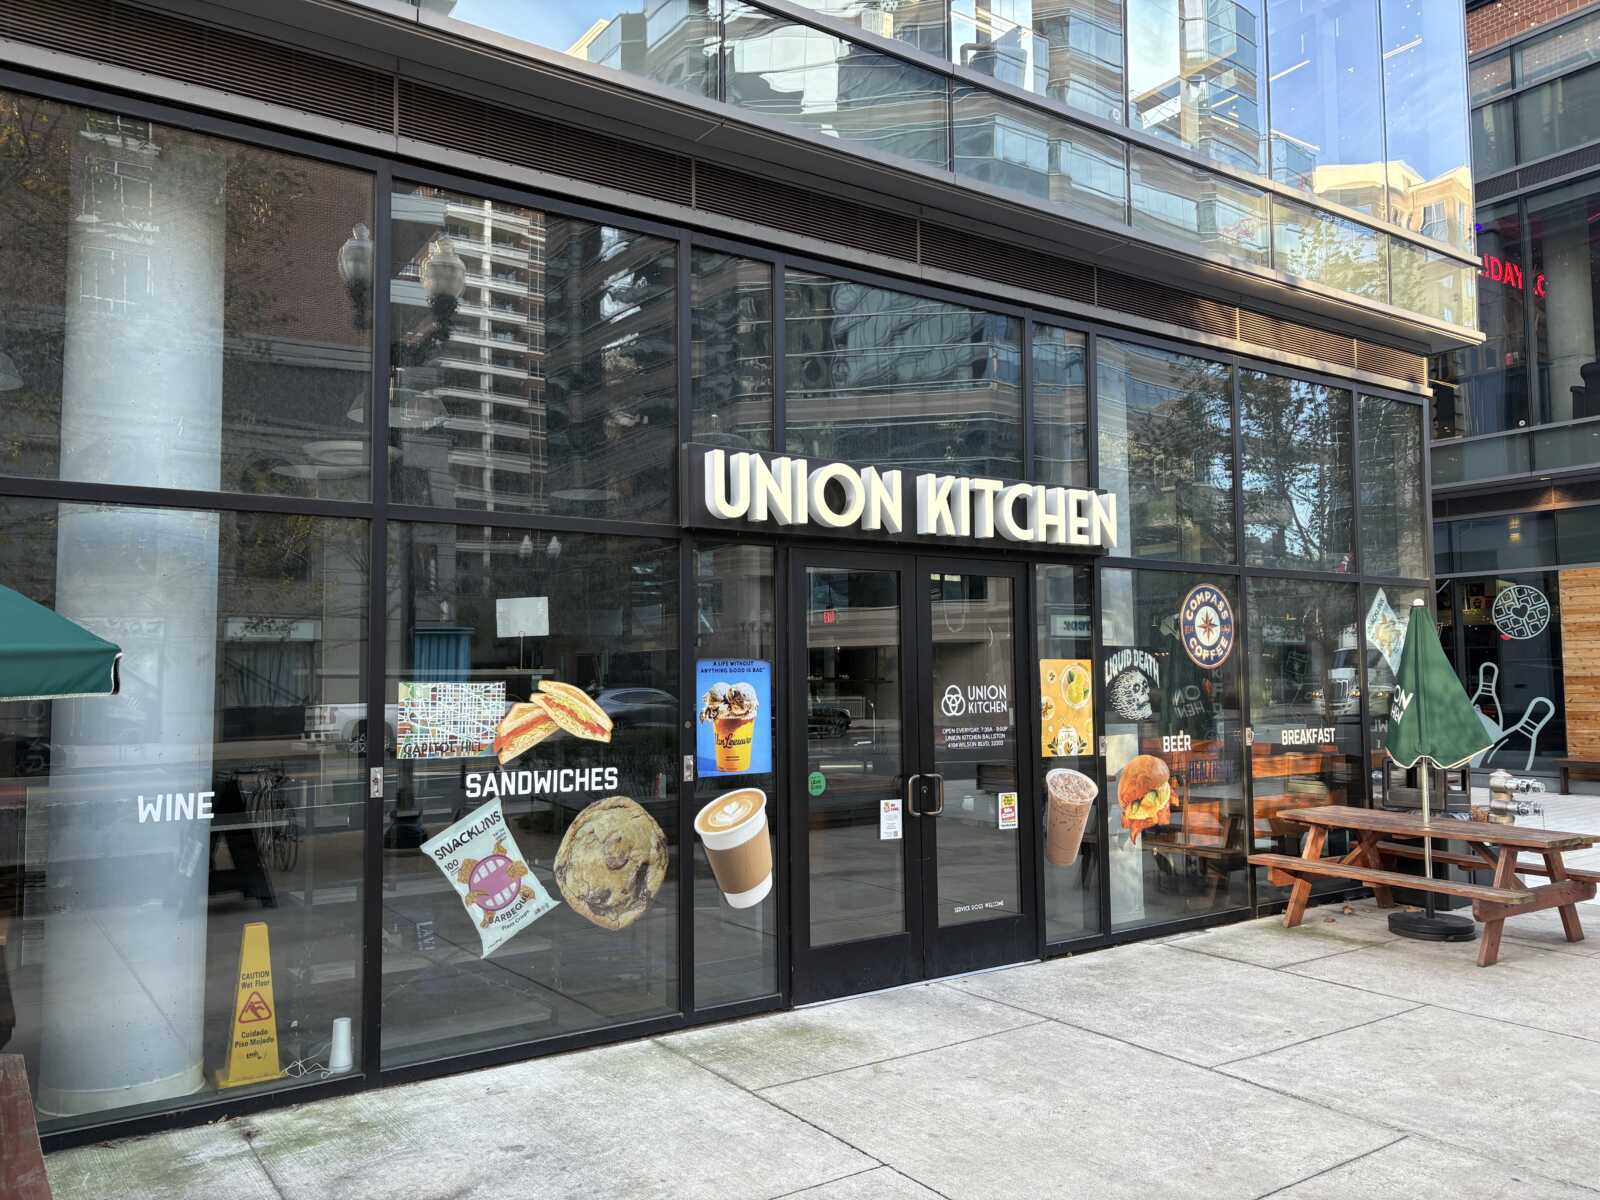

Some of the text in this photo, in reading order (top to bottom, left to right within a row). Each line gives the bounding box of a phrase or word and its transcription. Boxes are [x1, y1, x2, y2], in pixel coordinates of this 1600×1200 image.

[704, 449, 1118, 548] UNION KITCHEN
[1186, 591, 1229, 621] COMPASS
[1189, 636, 1229, 660] COFFEE
[1105, 648, 1160, 688] LIQUID DEATH
[967, 684, 1007, 700] UNION
[968, 700, 1008, 713] KITCHEN
[1162, 734, 1192, 753] BEER
[1281, 727, 1336, 746] BREAKFAST
[404, 740, 484, 755] CAPITOL HILL
[465, 767, 618, 798] SANDWICHES
[137, 791, 215, 824] WINE
[434, 810, 501, 860] SNACKLINS
[444, 859, 459, 872] 100
[241, 970, 270, 981] CAUTION
[241, 979, 270, 989] Wet Floor
[234, 1037, 275, 1049] Piso Mojado
[241, 1028, 268, 1039] Cuidado
